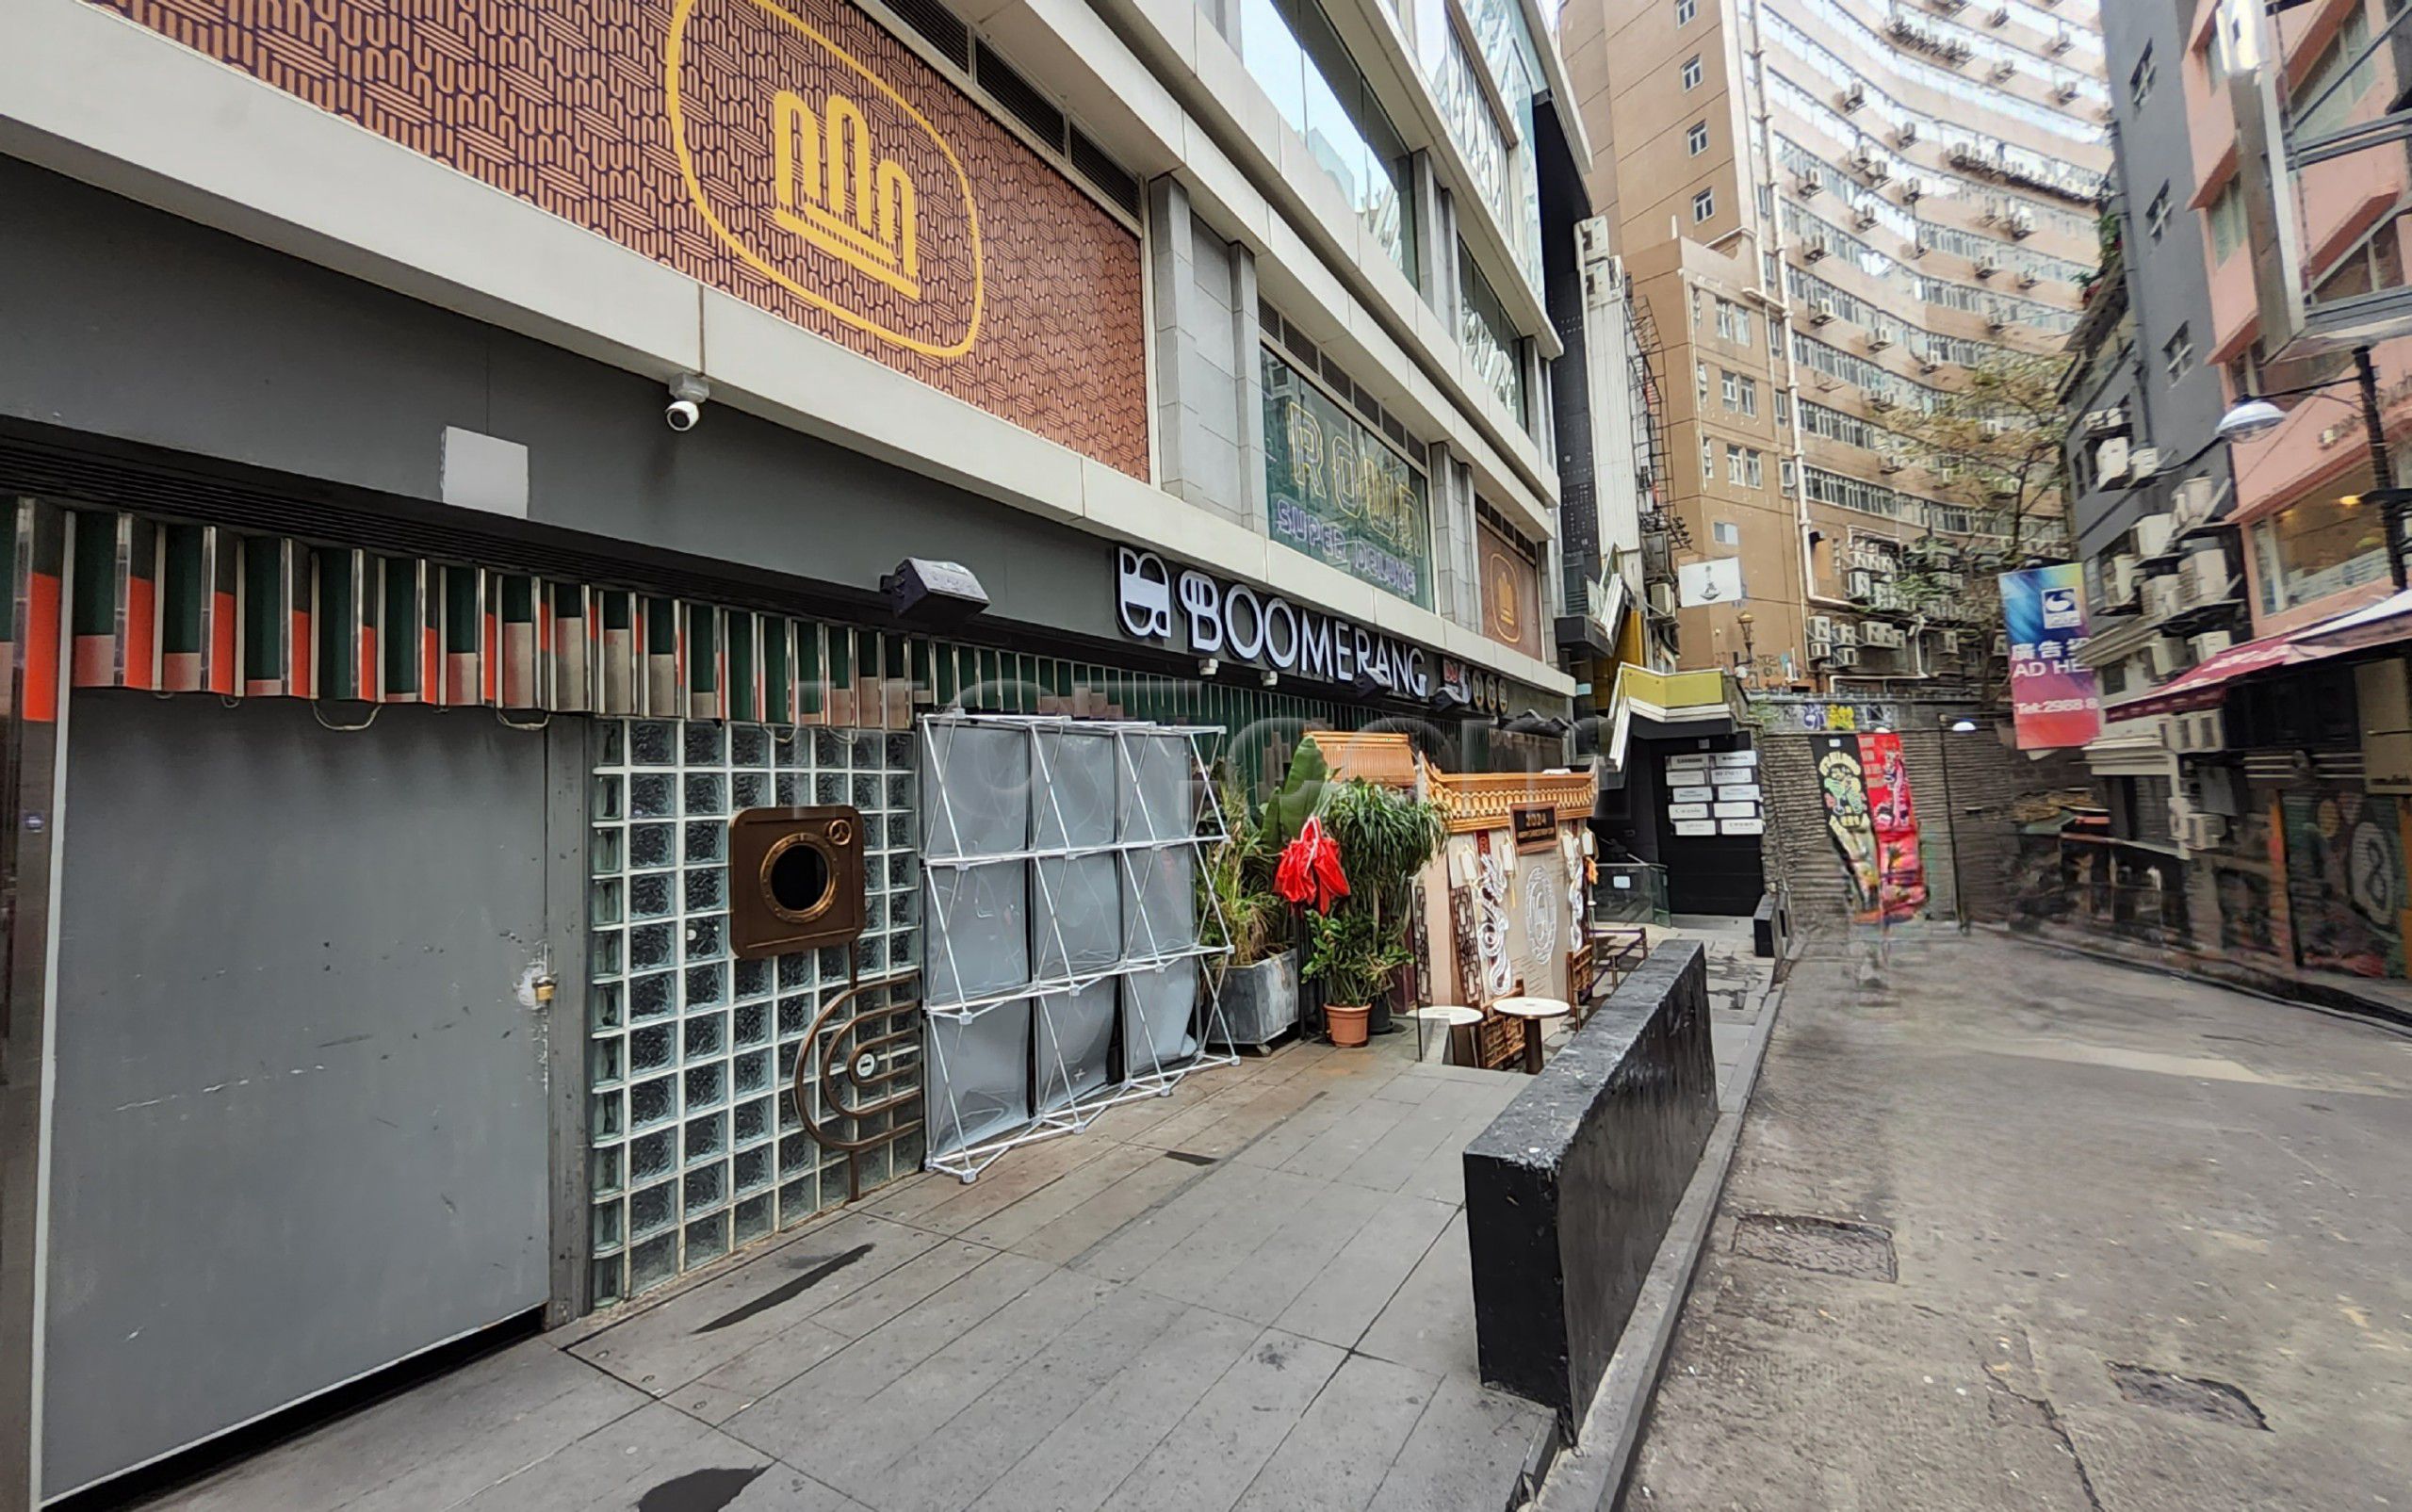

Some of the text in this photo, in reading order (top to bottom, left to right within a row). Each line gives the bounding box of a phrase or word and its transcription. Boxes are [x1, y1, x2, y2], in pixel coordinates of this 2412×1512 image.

[1179, 570, 1427, 697] BOOMERANG
[2013, 661, 2046, 678] AD
[1525, 812, 1546, 827] 2024
